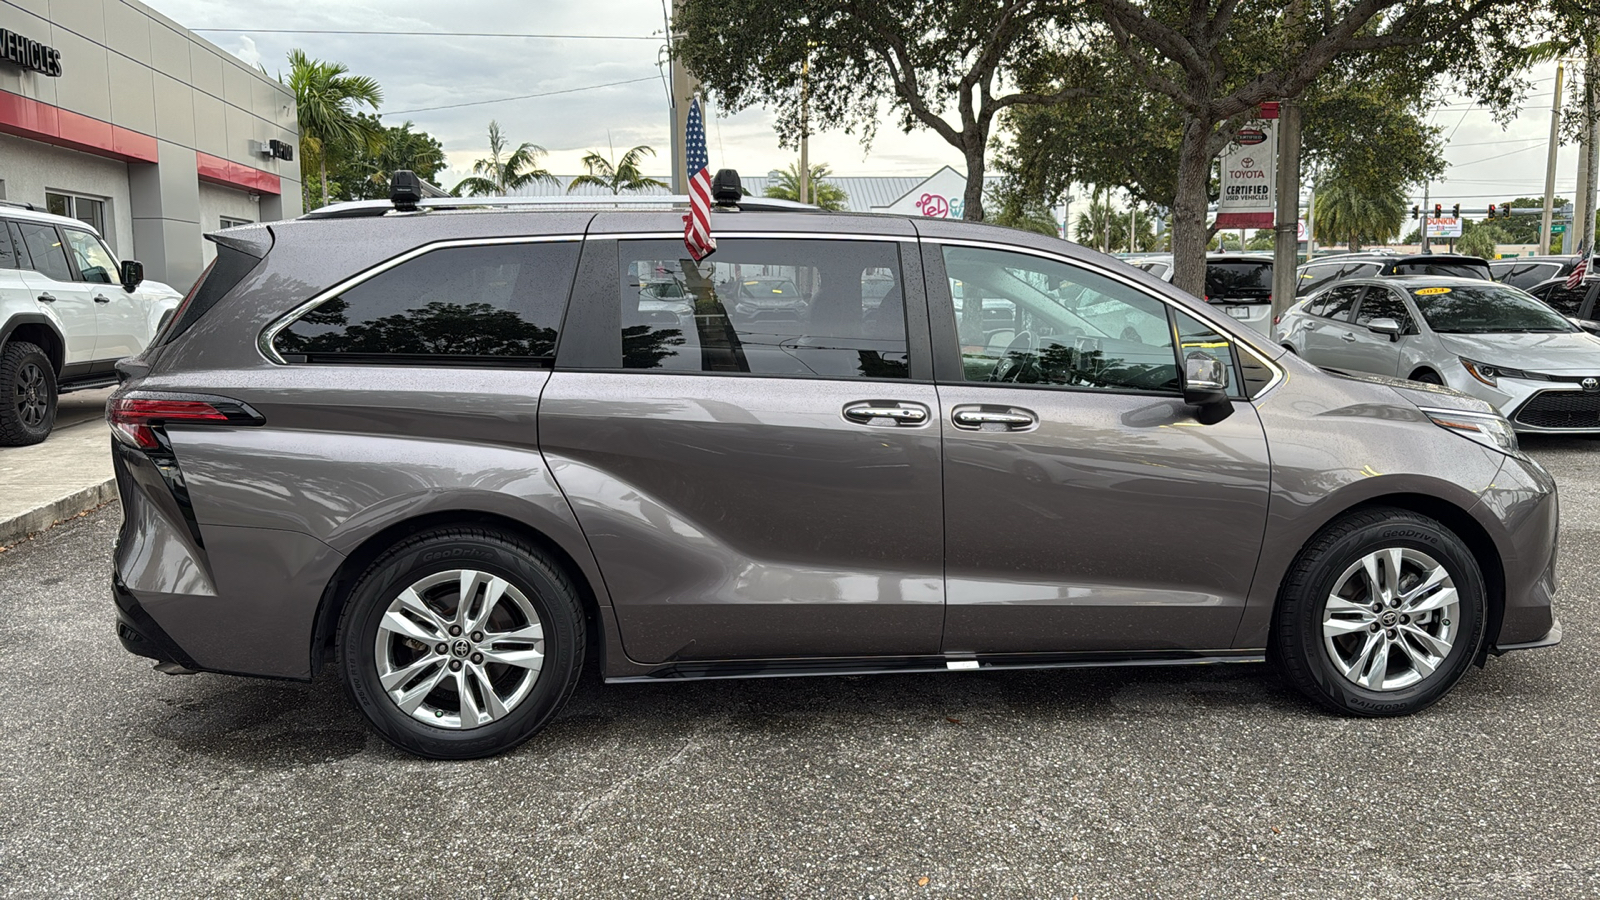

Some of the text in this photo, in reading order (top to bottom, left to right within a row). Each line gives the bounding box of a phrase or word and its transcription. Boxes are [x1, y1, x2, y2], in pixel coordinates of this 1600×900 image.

[0, 27, 62, 77] VEHICLES
[1229, 170, 1265, 178] TOYOTA
[1226, 185, 1269, 194] CERTIFIED
[1382, 529, 1438, 544] GeoDrive
